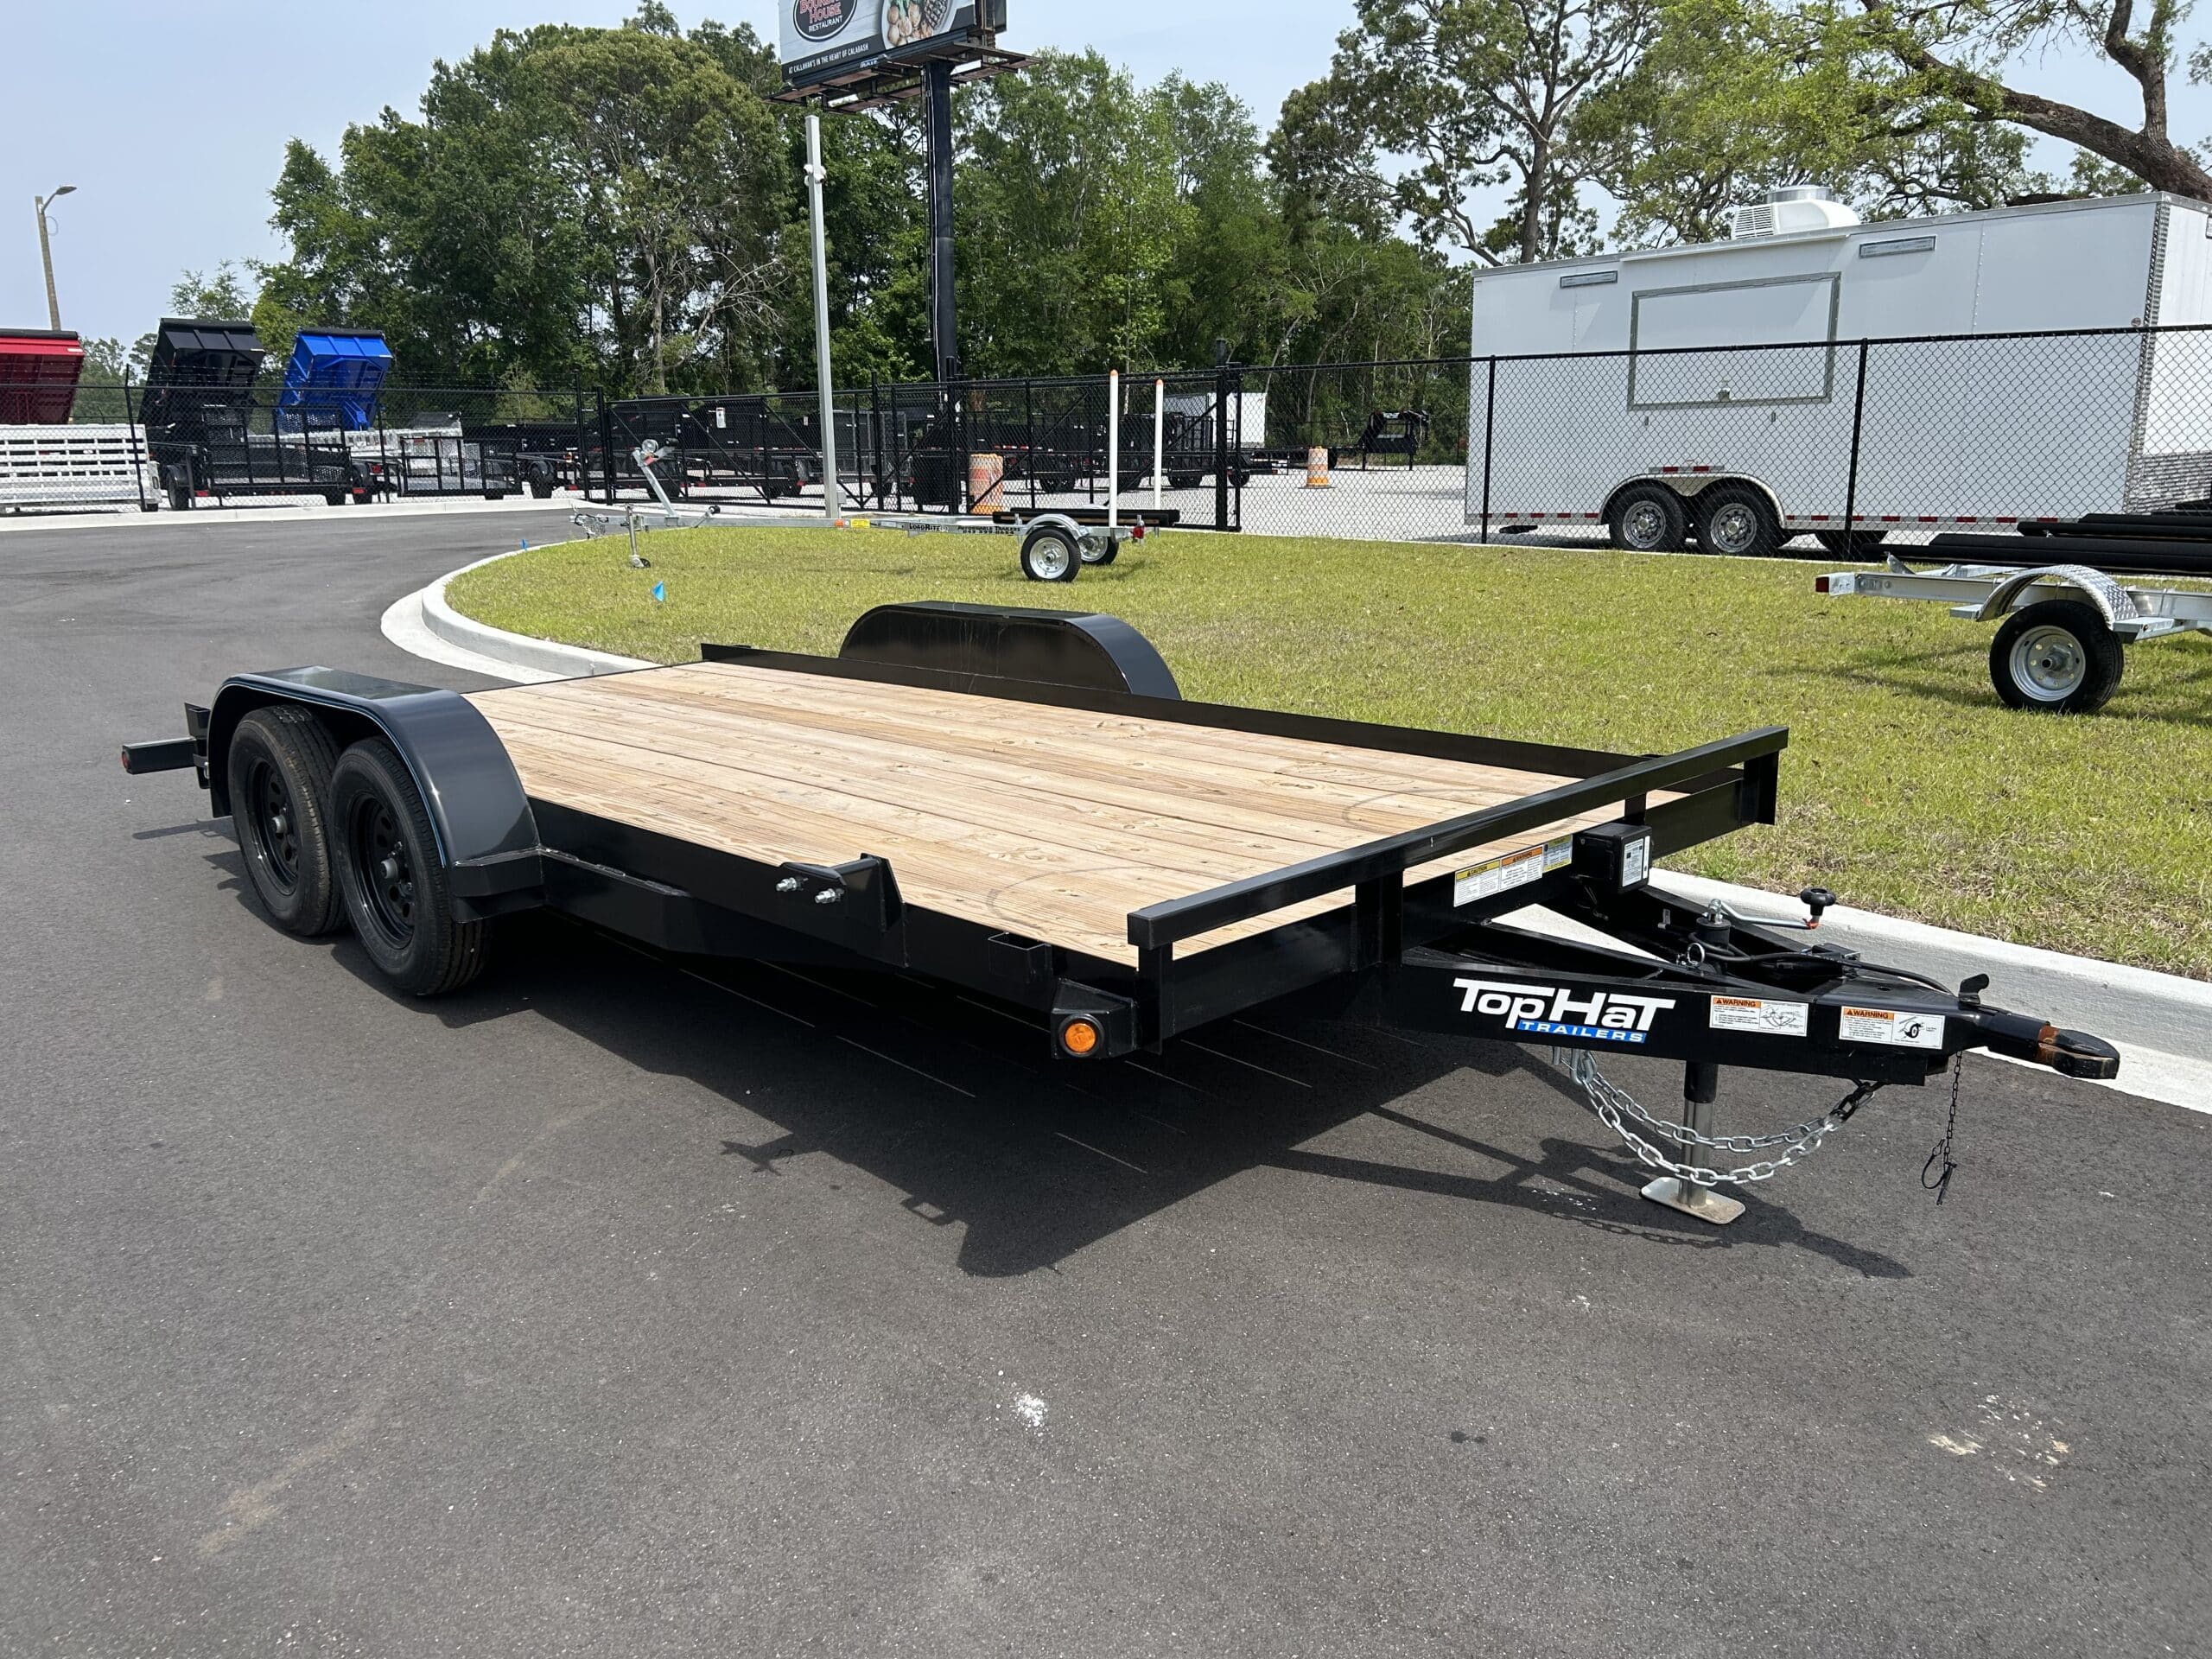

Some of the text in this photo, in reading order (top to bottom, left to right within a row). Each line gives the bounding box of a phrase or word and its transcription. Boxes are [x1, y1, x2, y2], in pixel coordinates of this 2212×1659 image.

[809, 2, 842, 23] HOUSE
[808, 15, 843, 33] RESTAURANT
[829, 51, 842, 61] HEART
[842, 49, 848, 58] OF
[848, 43, 868, 56] CALABASH
[1722, 999, 1757, 1007] WARNING
[1853, 1009, 1889, 1019] WARNING
[1522, 1020, 1644, 1042] TRAILERS
